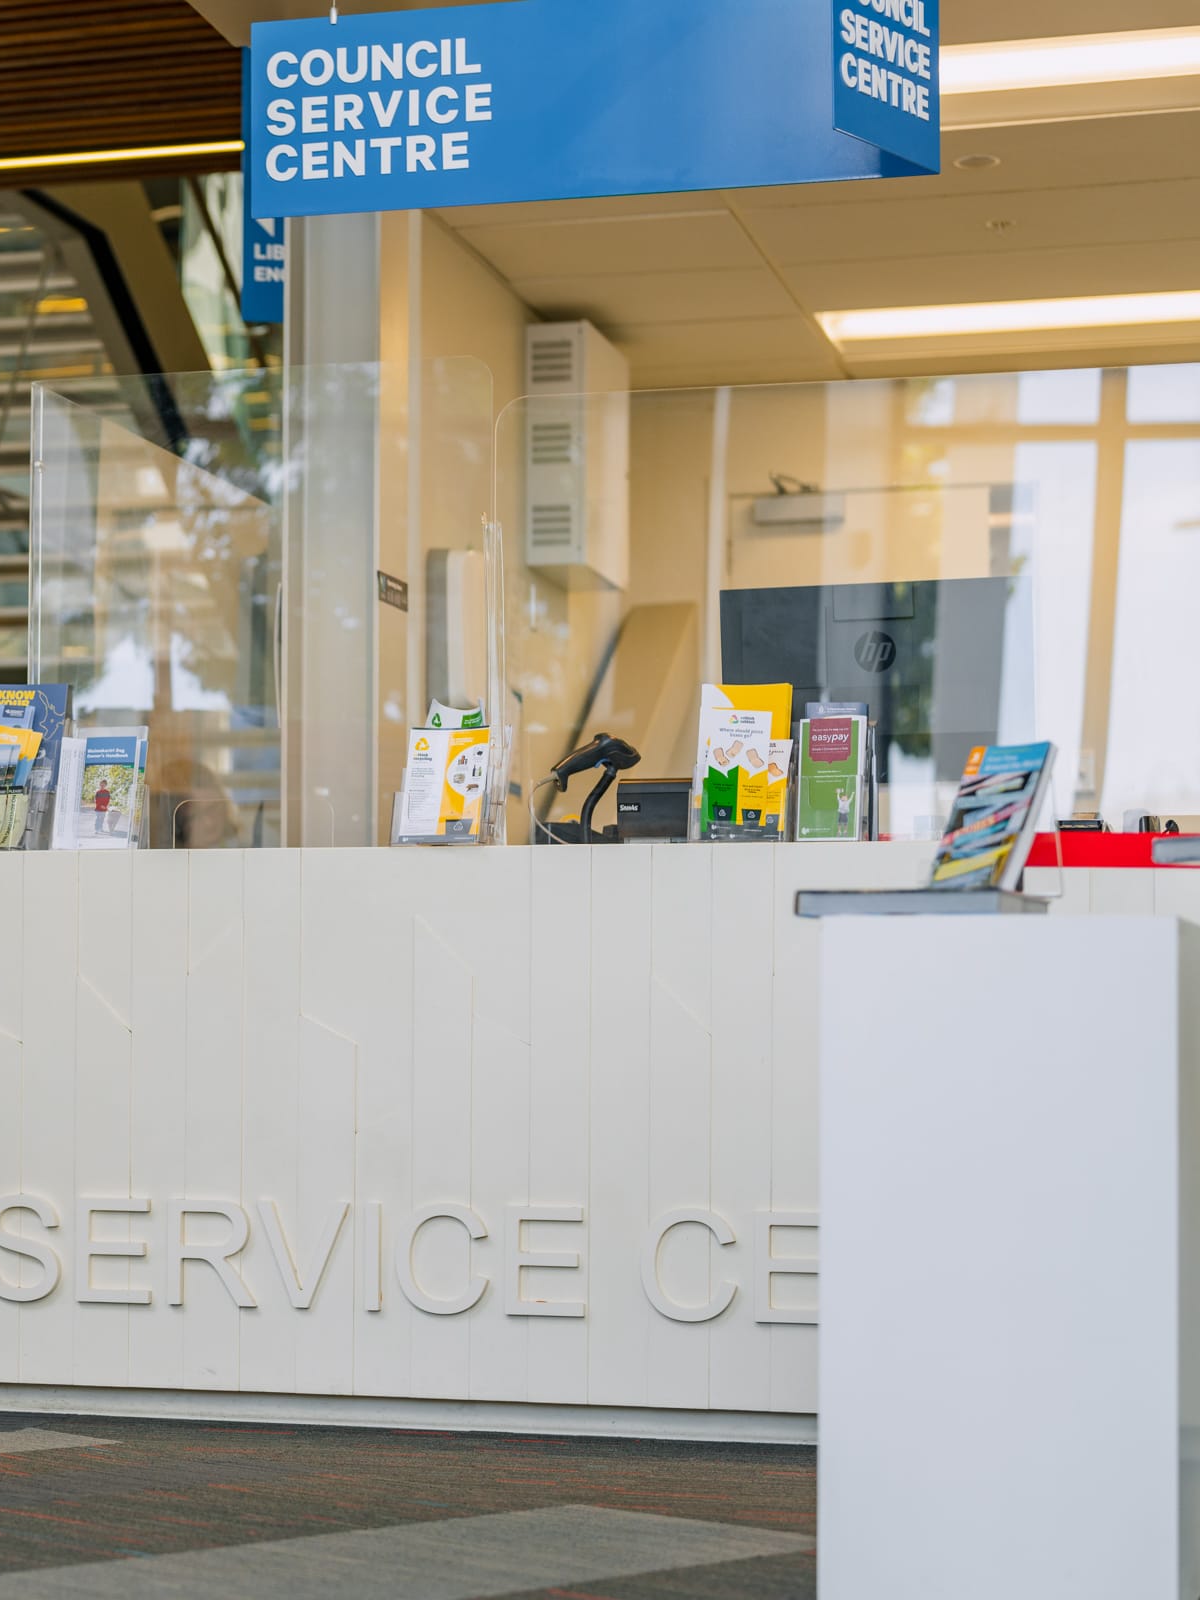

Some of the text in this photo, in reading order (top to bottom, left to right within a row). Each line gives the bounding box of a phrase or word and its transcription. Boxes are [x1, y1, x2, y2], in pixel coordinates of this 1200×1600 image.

[841, 9, 931, 80] SERVICE
[858, 0, 931, 38] NCIL
[266, 38, 482, 89] COUNCIL
[841, 52, 930, 121] CENTRE
[266, 84, 493, 136] SERVICE
[265, 131, 470, 183] CENTRE
[811, 733, 849, 744] easypay
